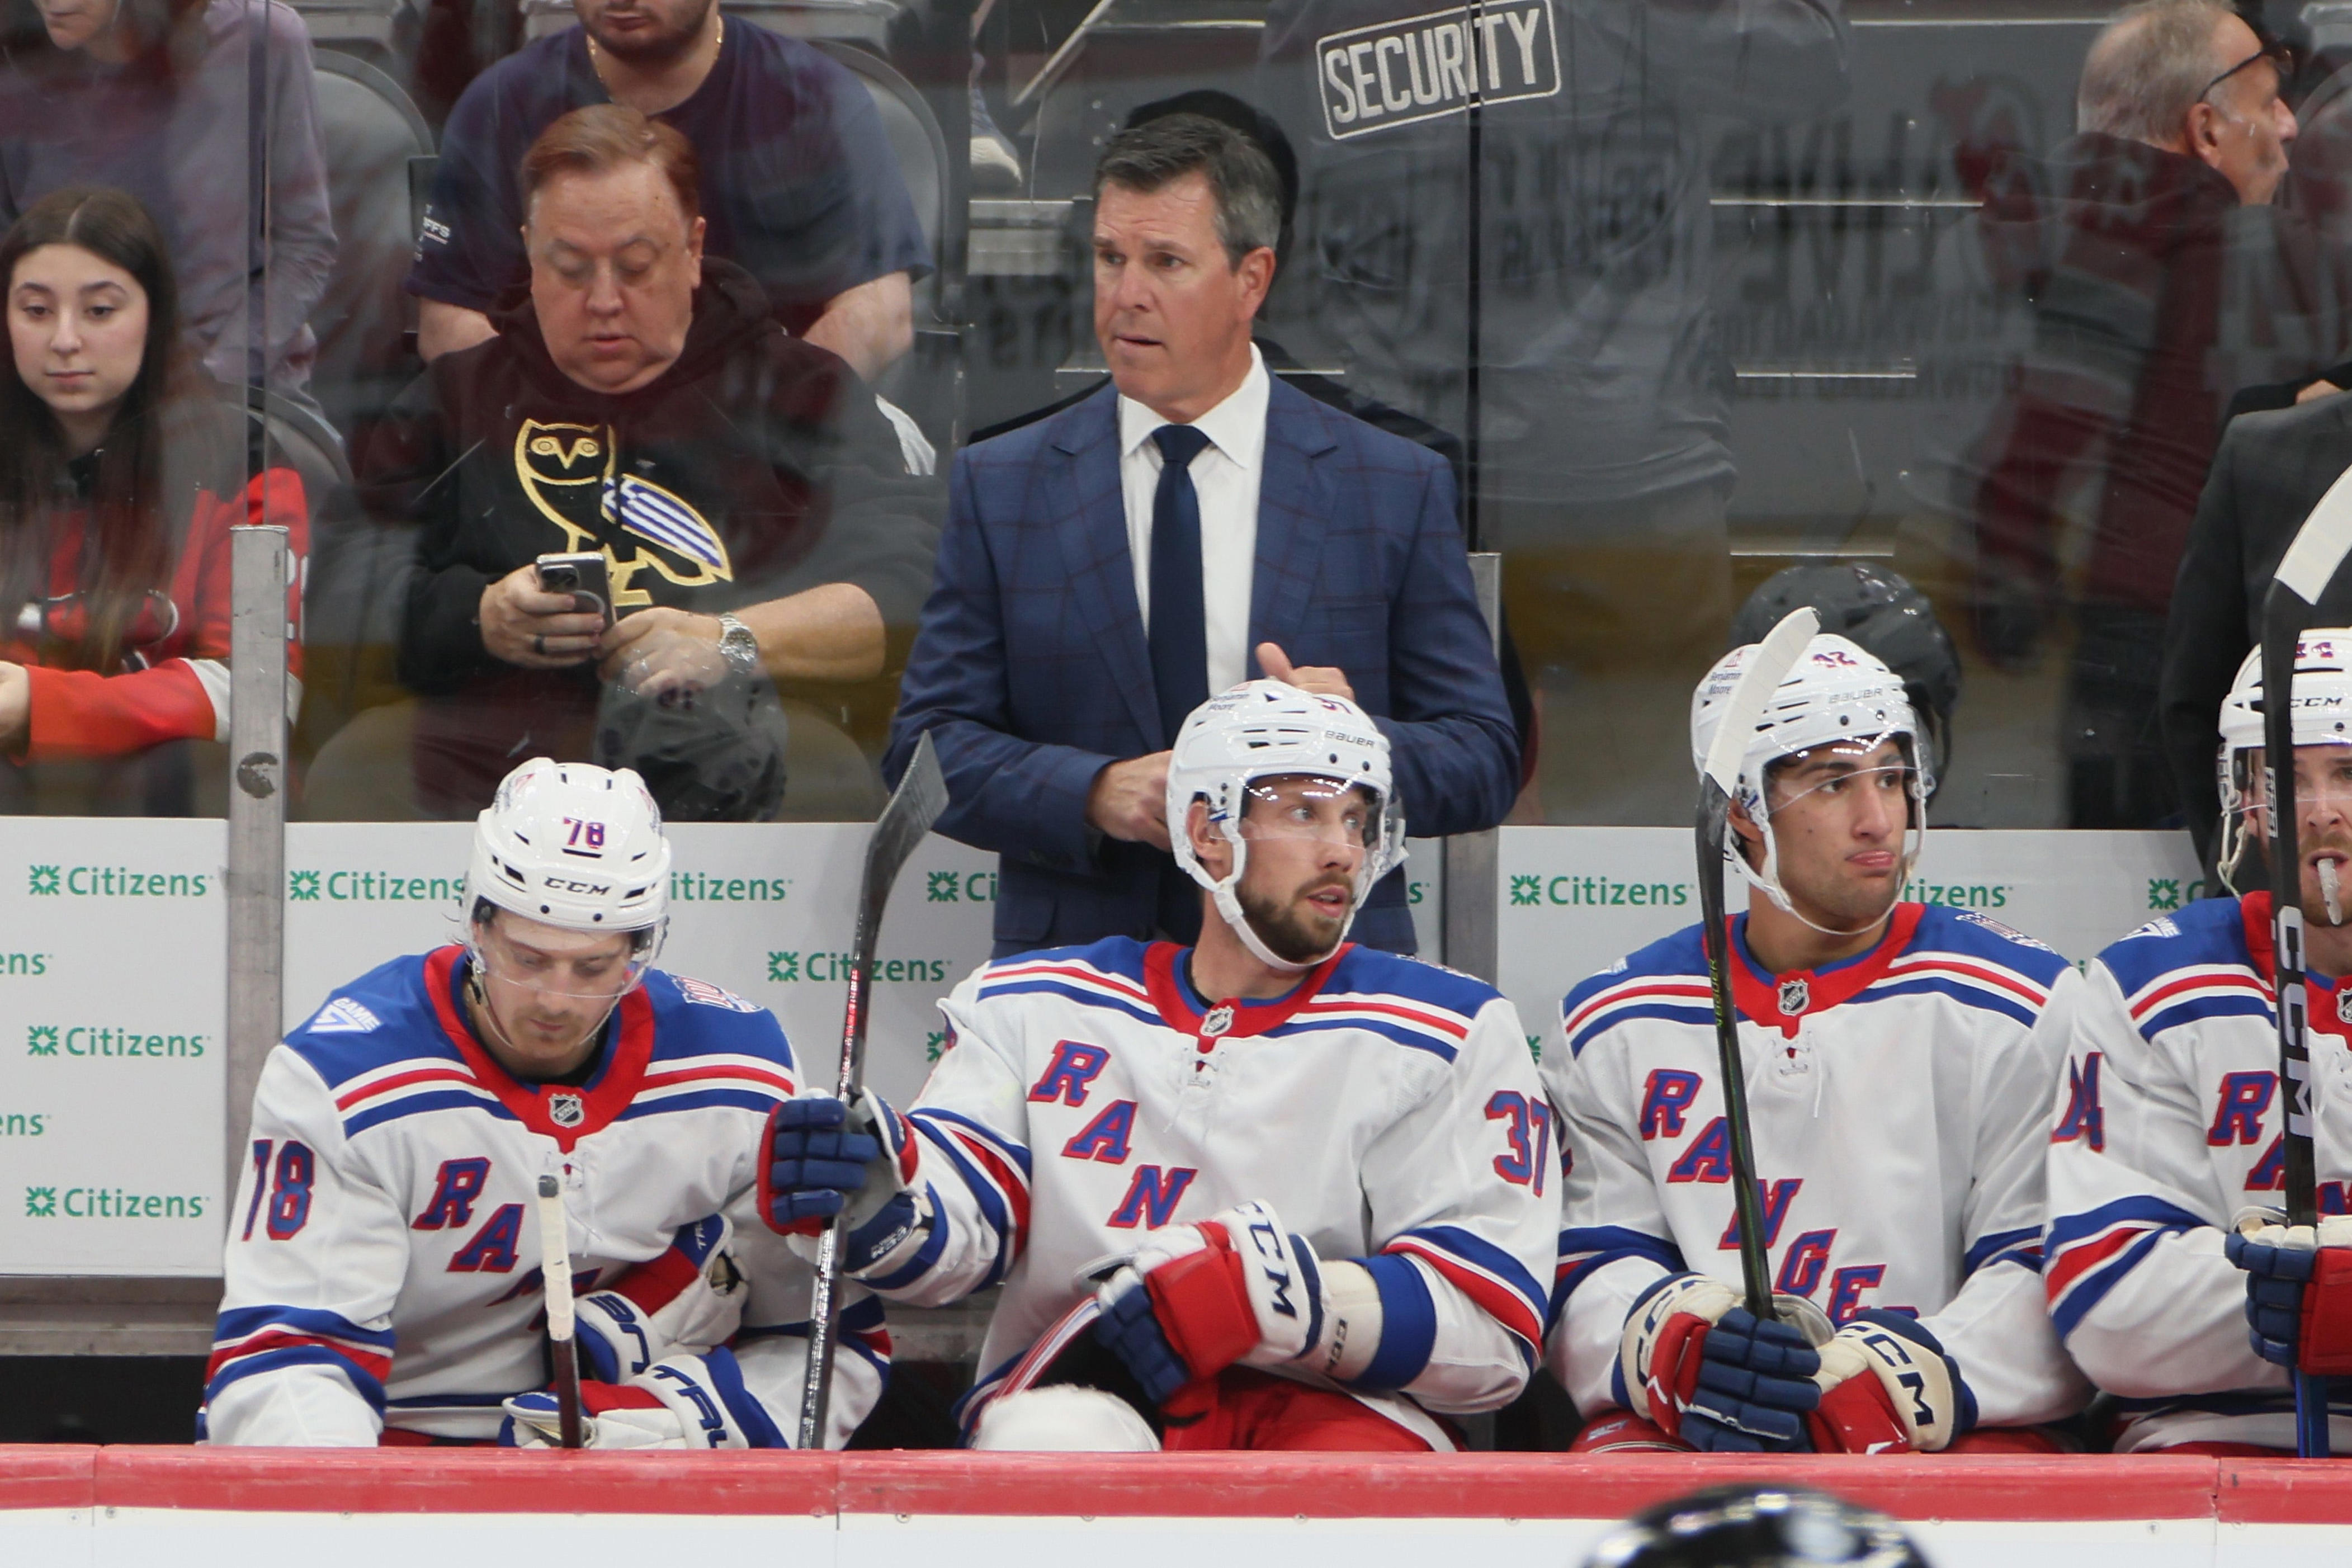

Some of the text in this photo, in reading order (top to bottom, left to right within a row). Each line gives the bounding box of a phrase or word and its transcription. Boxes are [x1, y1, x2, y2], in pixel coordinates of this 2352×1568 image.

[1324, 8, 1541, 123] SECURITY
[563, 816, 605, 849] 78
[68, 867, 207, 896] Citizens
[544, 877, 611, 895] CCM
[671, 872, 786, 901] itizens
[1548, 876, 1686, 905] Citizens
[1904, 878, 2005, 907] tizens
[806, 952, 944, 982] Citzens
[2277, 911, 2315, 1139] CCM
[66, 1027, 204, 1057] Citizens
[1486, 1090, 1550, 1197] 37
[64, 1188, 203, 1218] Citizens
[243, 1140, 314, 1241] 78
[1640, 1069, 1919, 1325] RANGE
